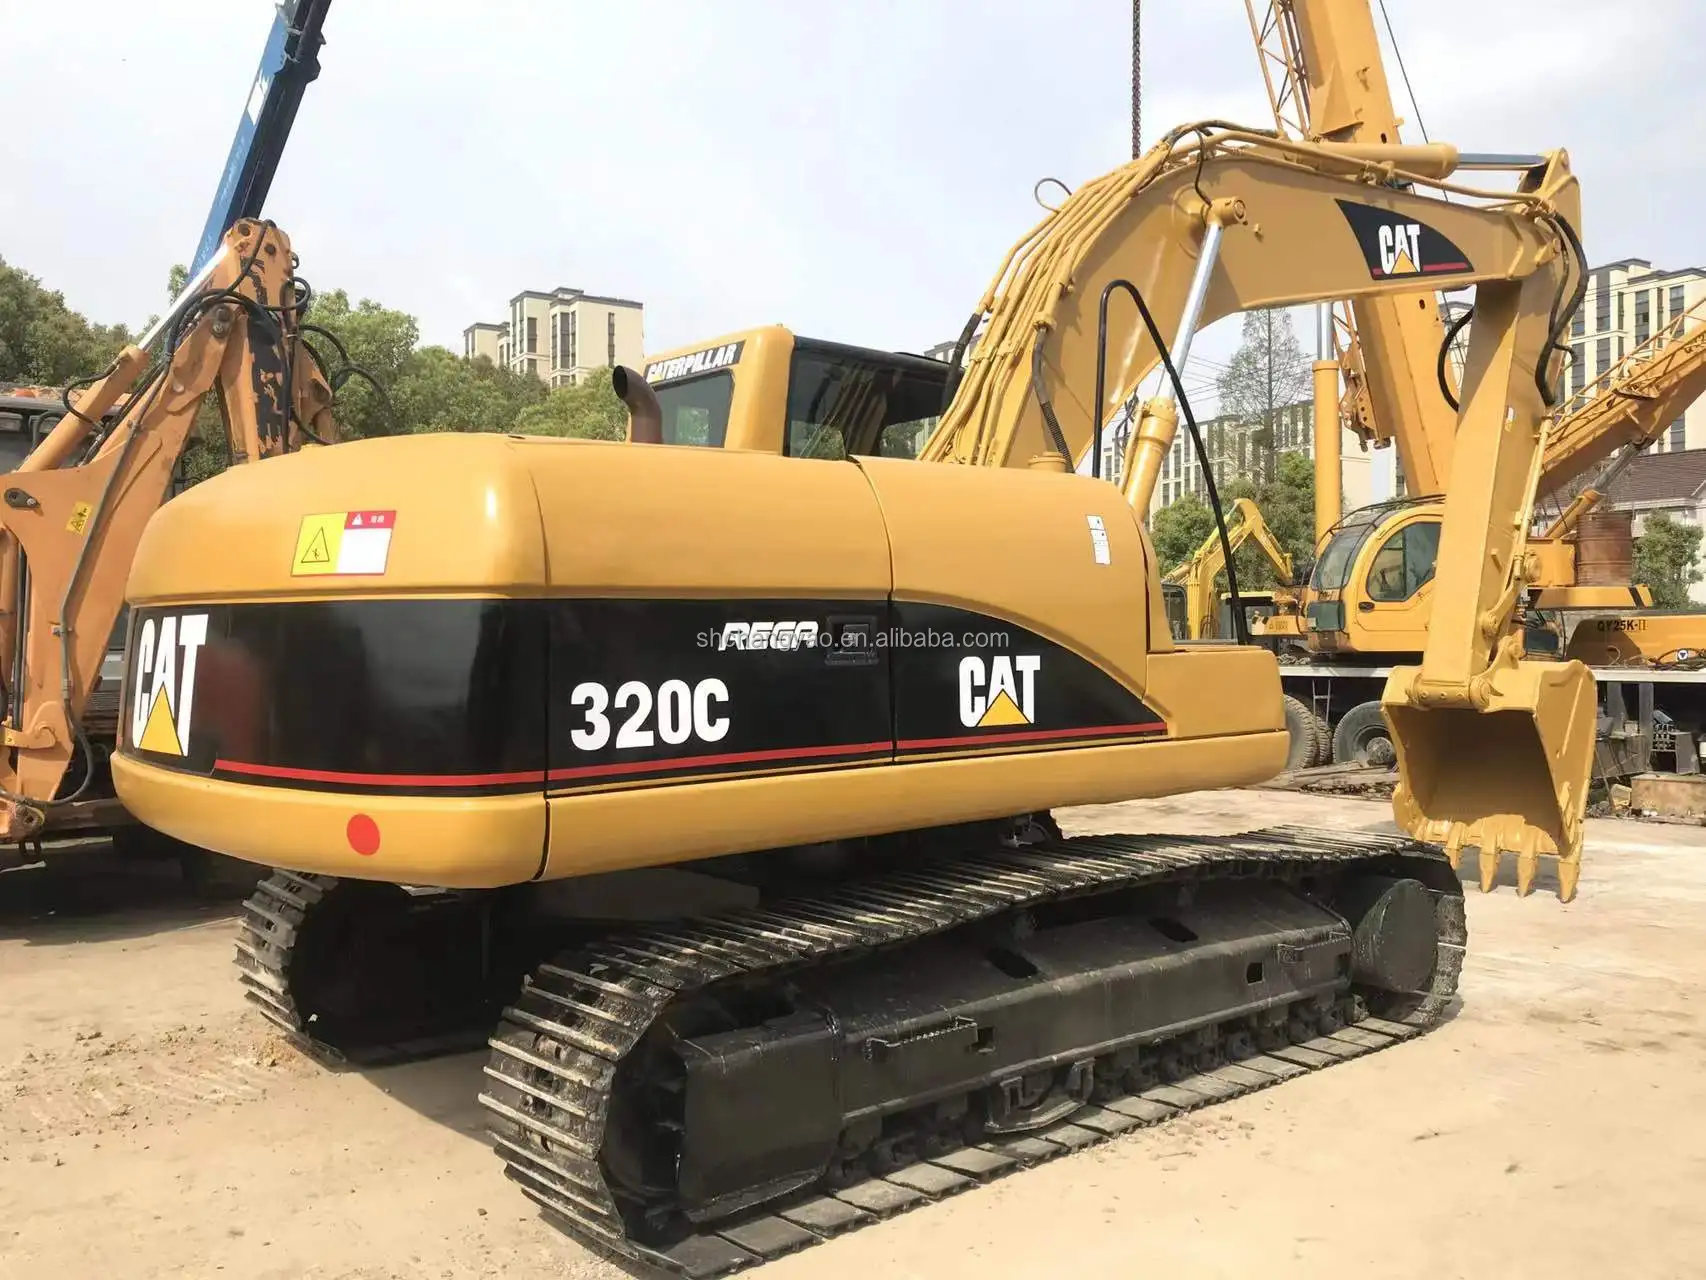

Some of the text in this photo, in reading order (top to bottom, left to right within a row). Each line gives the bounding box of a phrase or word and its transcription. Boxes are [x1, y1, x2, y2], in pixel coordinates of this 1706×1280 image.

[1378, 224, 1420, 274] CAT
[646, 343, 737, 384] CATERPILLAR
[132, 614, 209, 757] CAT
[571, 678, 730, 750] 320C
[959, 655, 1040, 727] CAT
